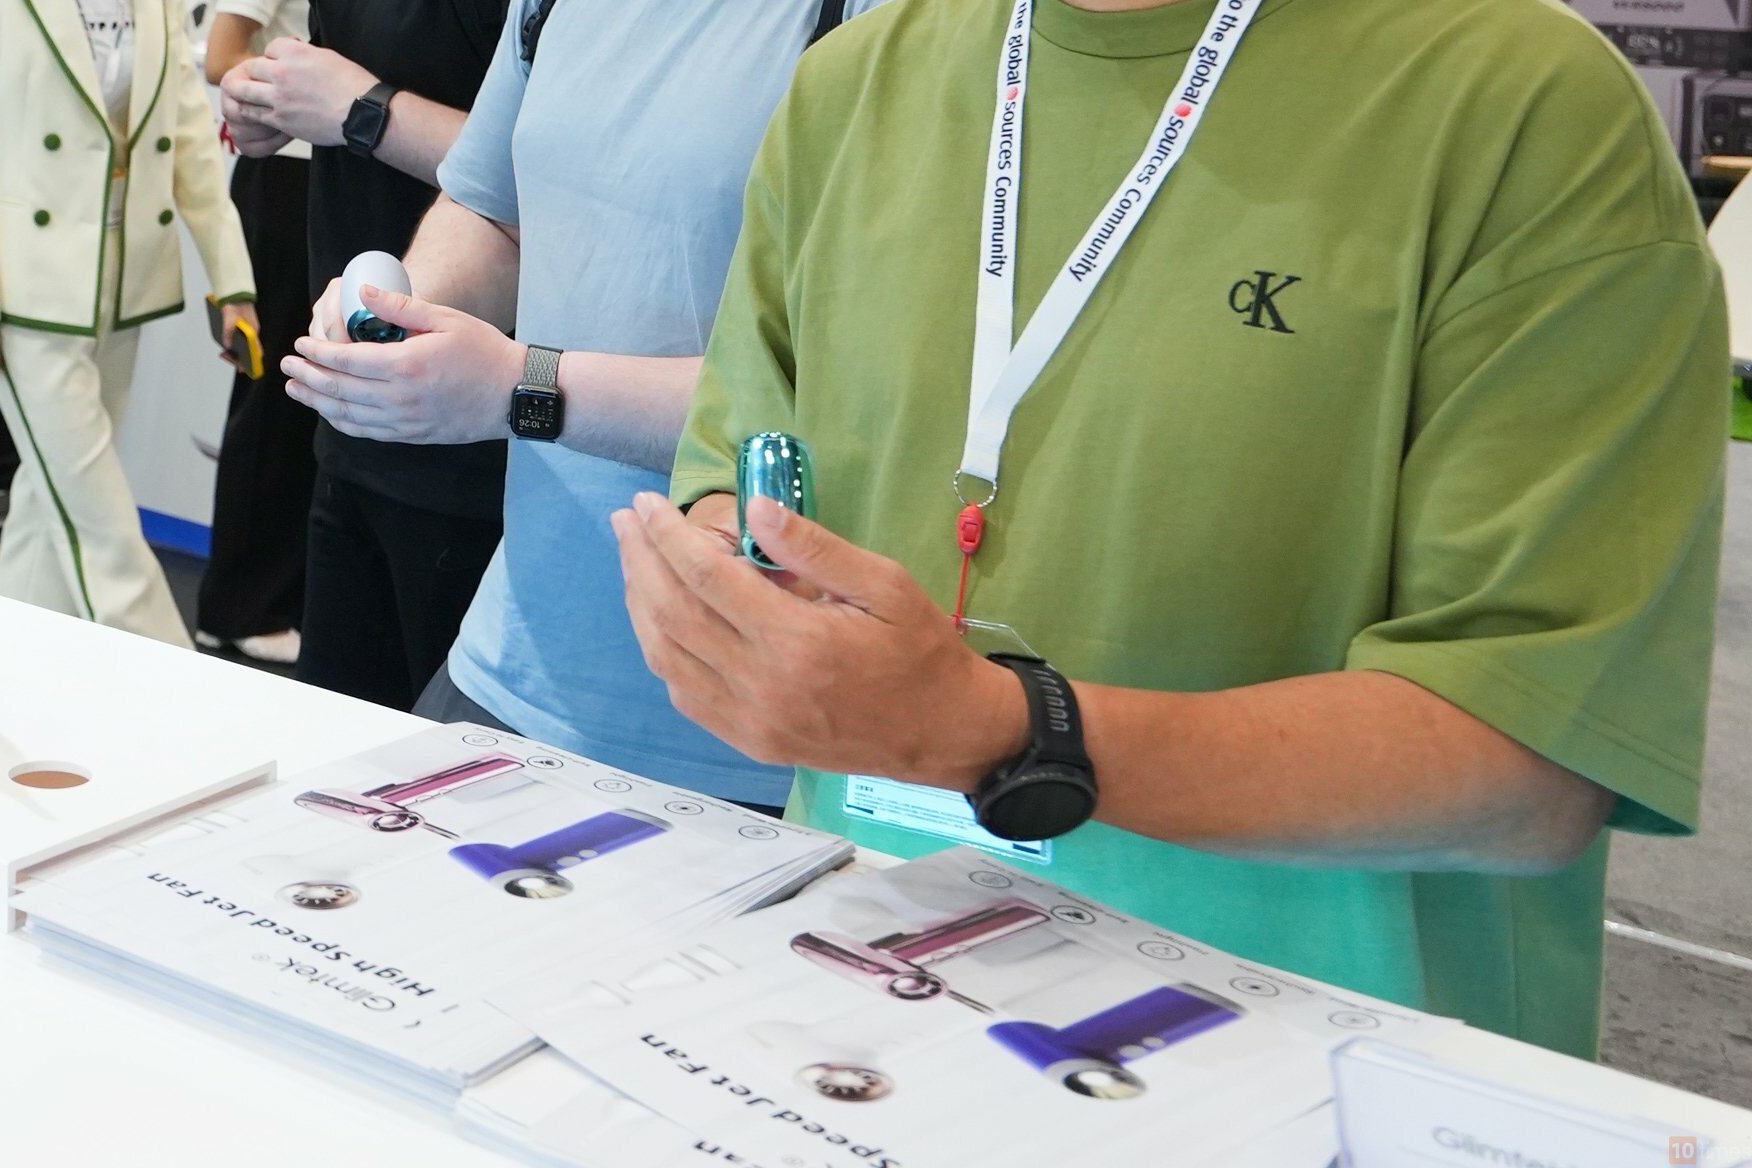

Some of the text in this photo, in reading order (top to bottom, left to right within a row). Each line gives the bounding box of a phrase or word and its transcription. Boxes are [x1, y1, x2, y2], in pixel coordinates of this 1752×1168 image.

[1014, 1, 1027, 30] the
[1210, 14, 1239, 43] the
[985, 176, 1012, 278] Community
[1068, 188, 1142, 282] Community
[146, 872, 436, 998] High Speed Jet Fan
[275, 956, 396, 1012] Glimtek
[639, 1033, 709, 1075] Fan
[710, 1074, 777, 1107] Jet
